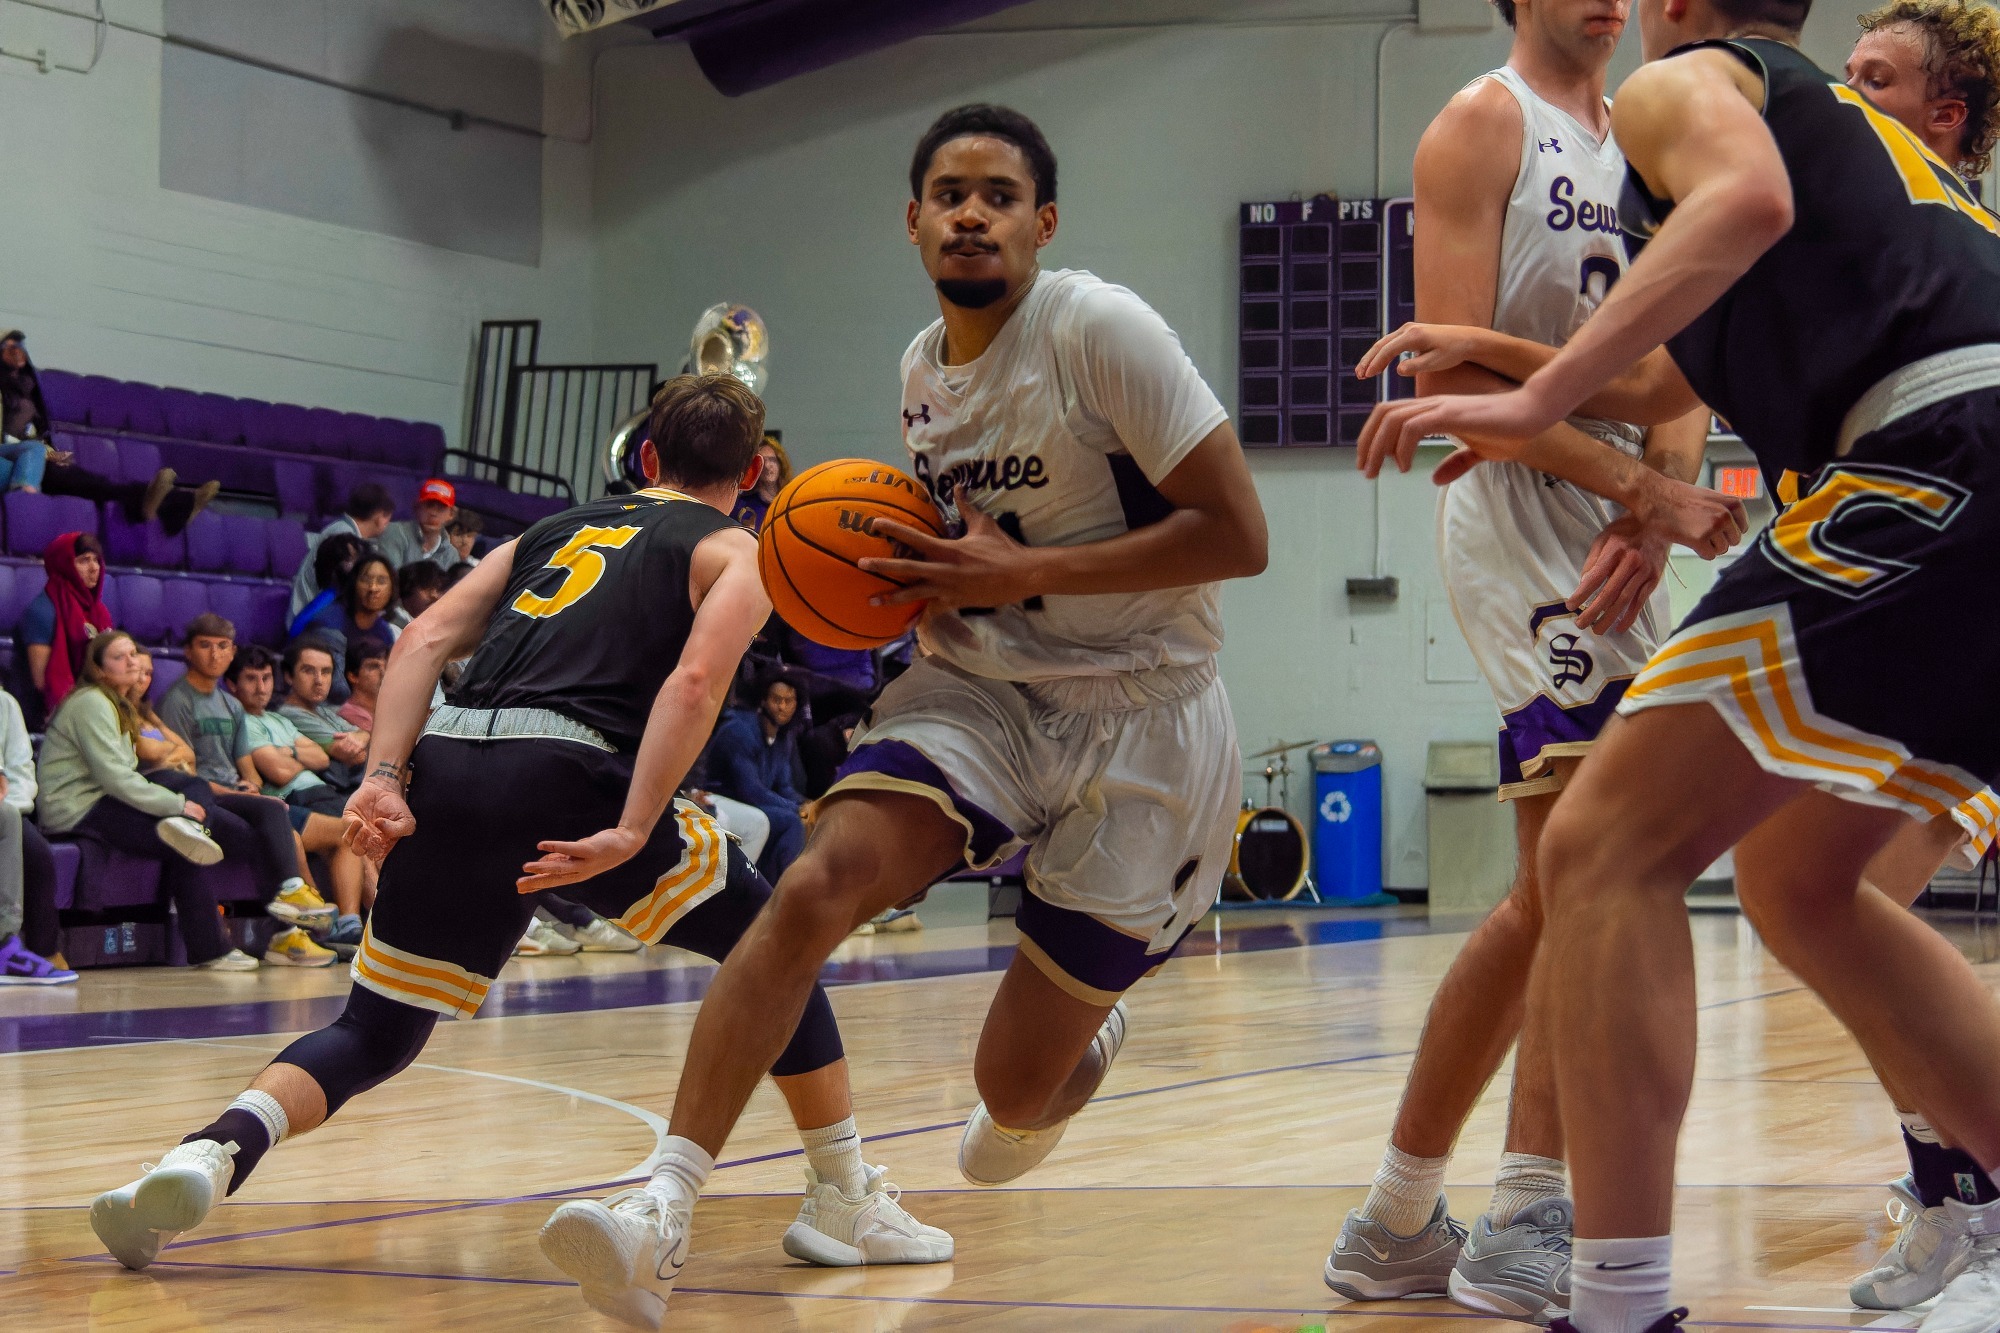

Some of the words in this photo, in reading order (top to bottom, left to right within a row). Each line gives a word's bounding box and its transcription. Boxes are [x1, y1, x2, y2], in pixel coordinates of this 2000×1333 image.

[1250, 203, 1276, 223] NO
[1302, 201, 1314, 222] F
[1339, 200, 1373, 220] PTS
[1722, 467, 1759, 498] EXIT
[1760, 462, 1973, 600] C
[511, 524, 643, 619] 5
[1549, 632, 1594, 690] S
